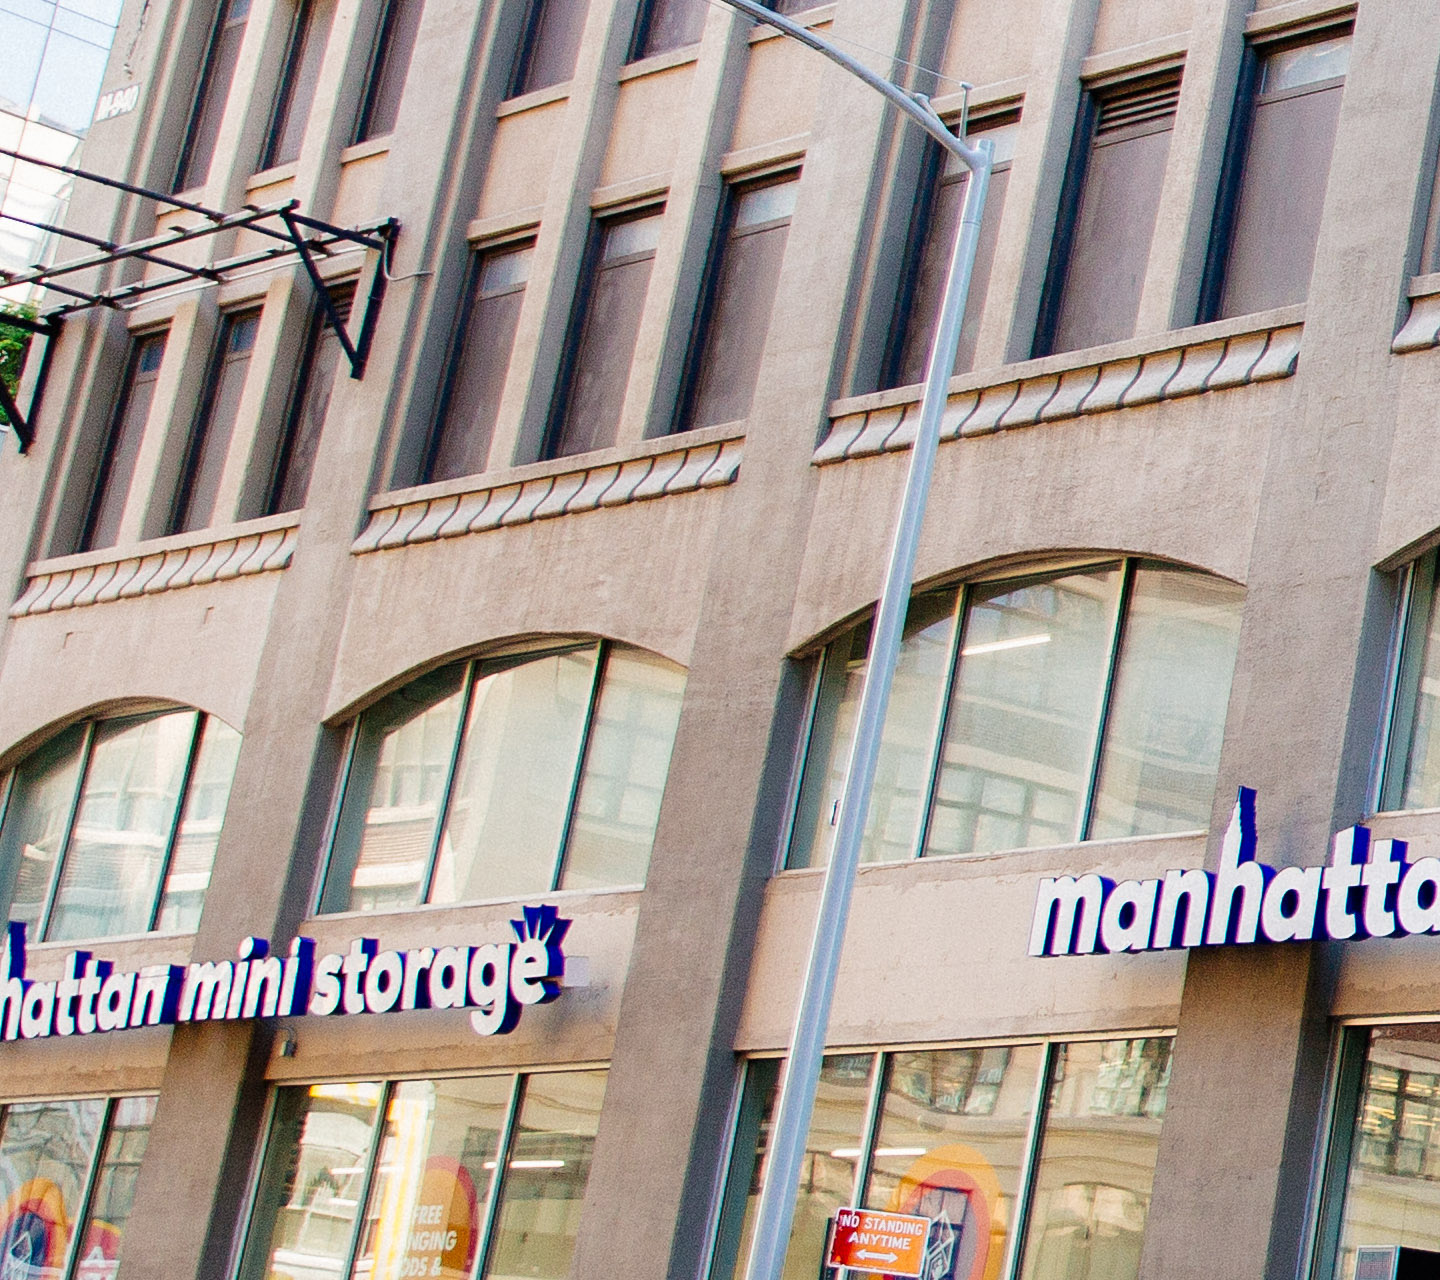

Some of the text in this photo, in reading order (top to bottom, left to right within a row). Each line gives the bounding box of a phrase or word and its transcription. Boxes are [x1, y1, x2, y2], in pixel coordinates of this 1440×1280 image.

[178, 936, 315, 1023] mini
[308, 908, 568, 1036] storage
[413, 1205, 443, 1225] FREE
[842, 1214, 923, 1236] NO STANDING
[407, 1230, 458, 1251] NGING
[848, 1231, 912, 1250] ANYTIME
